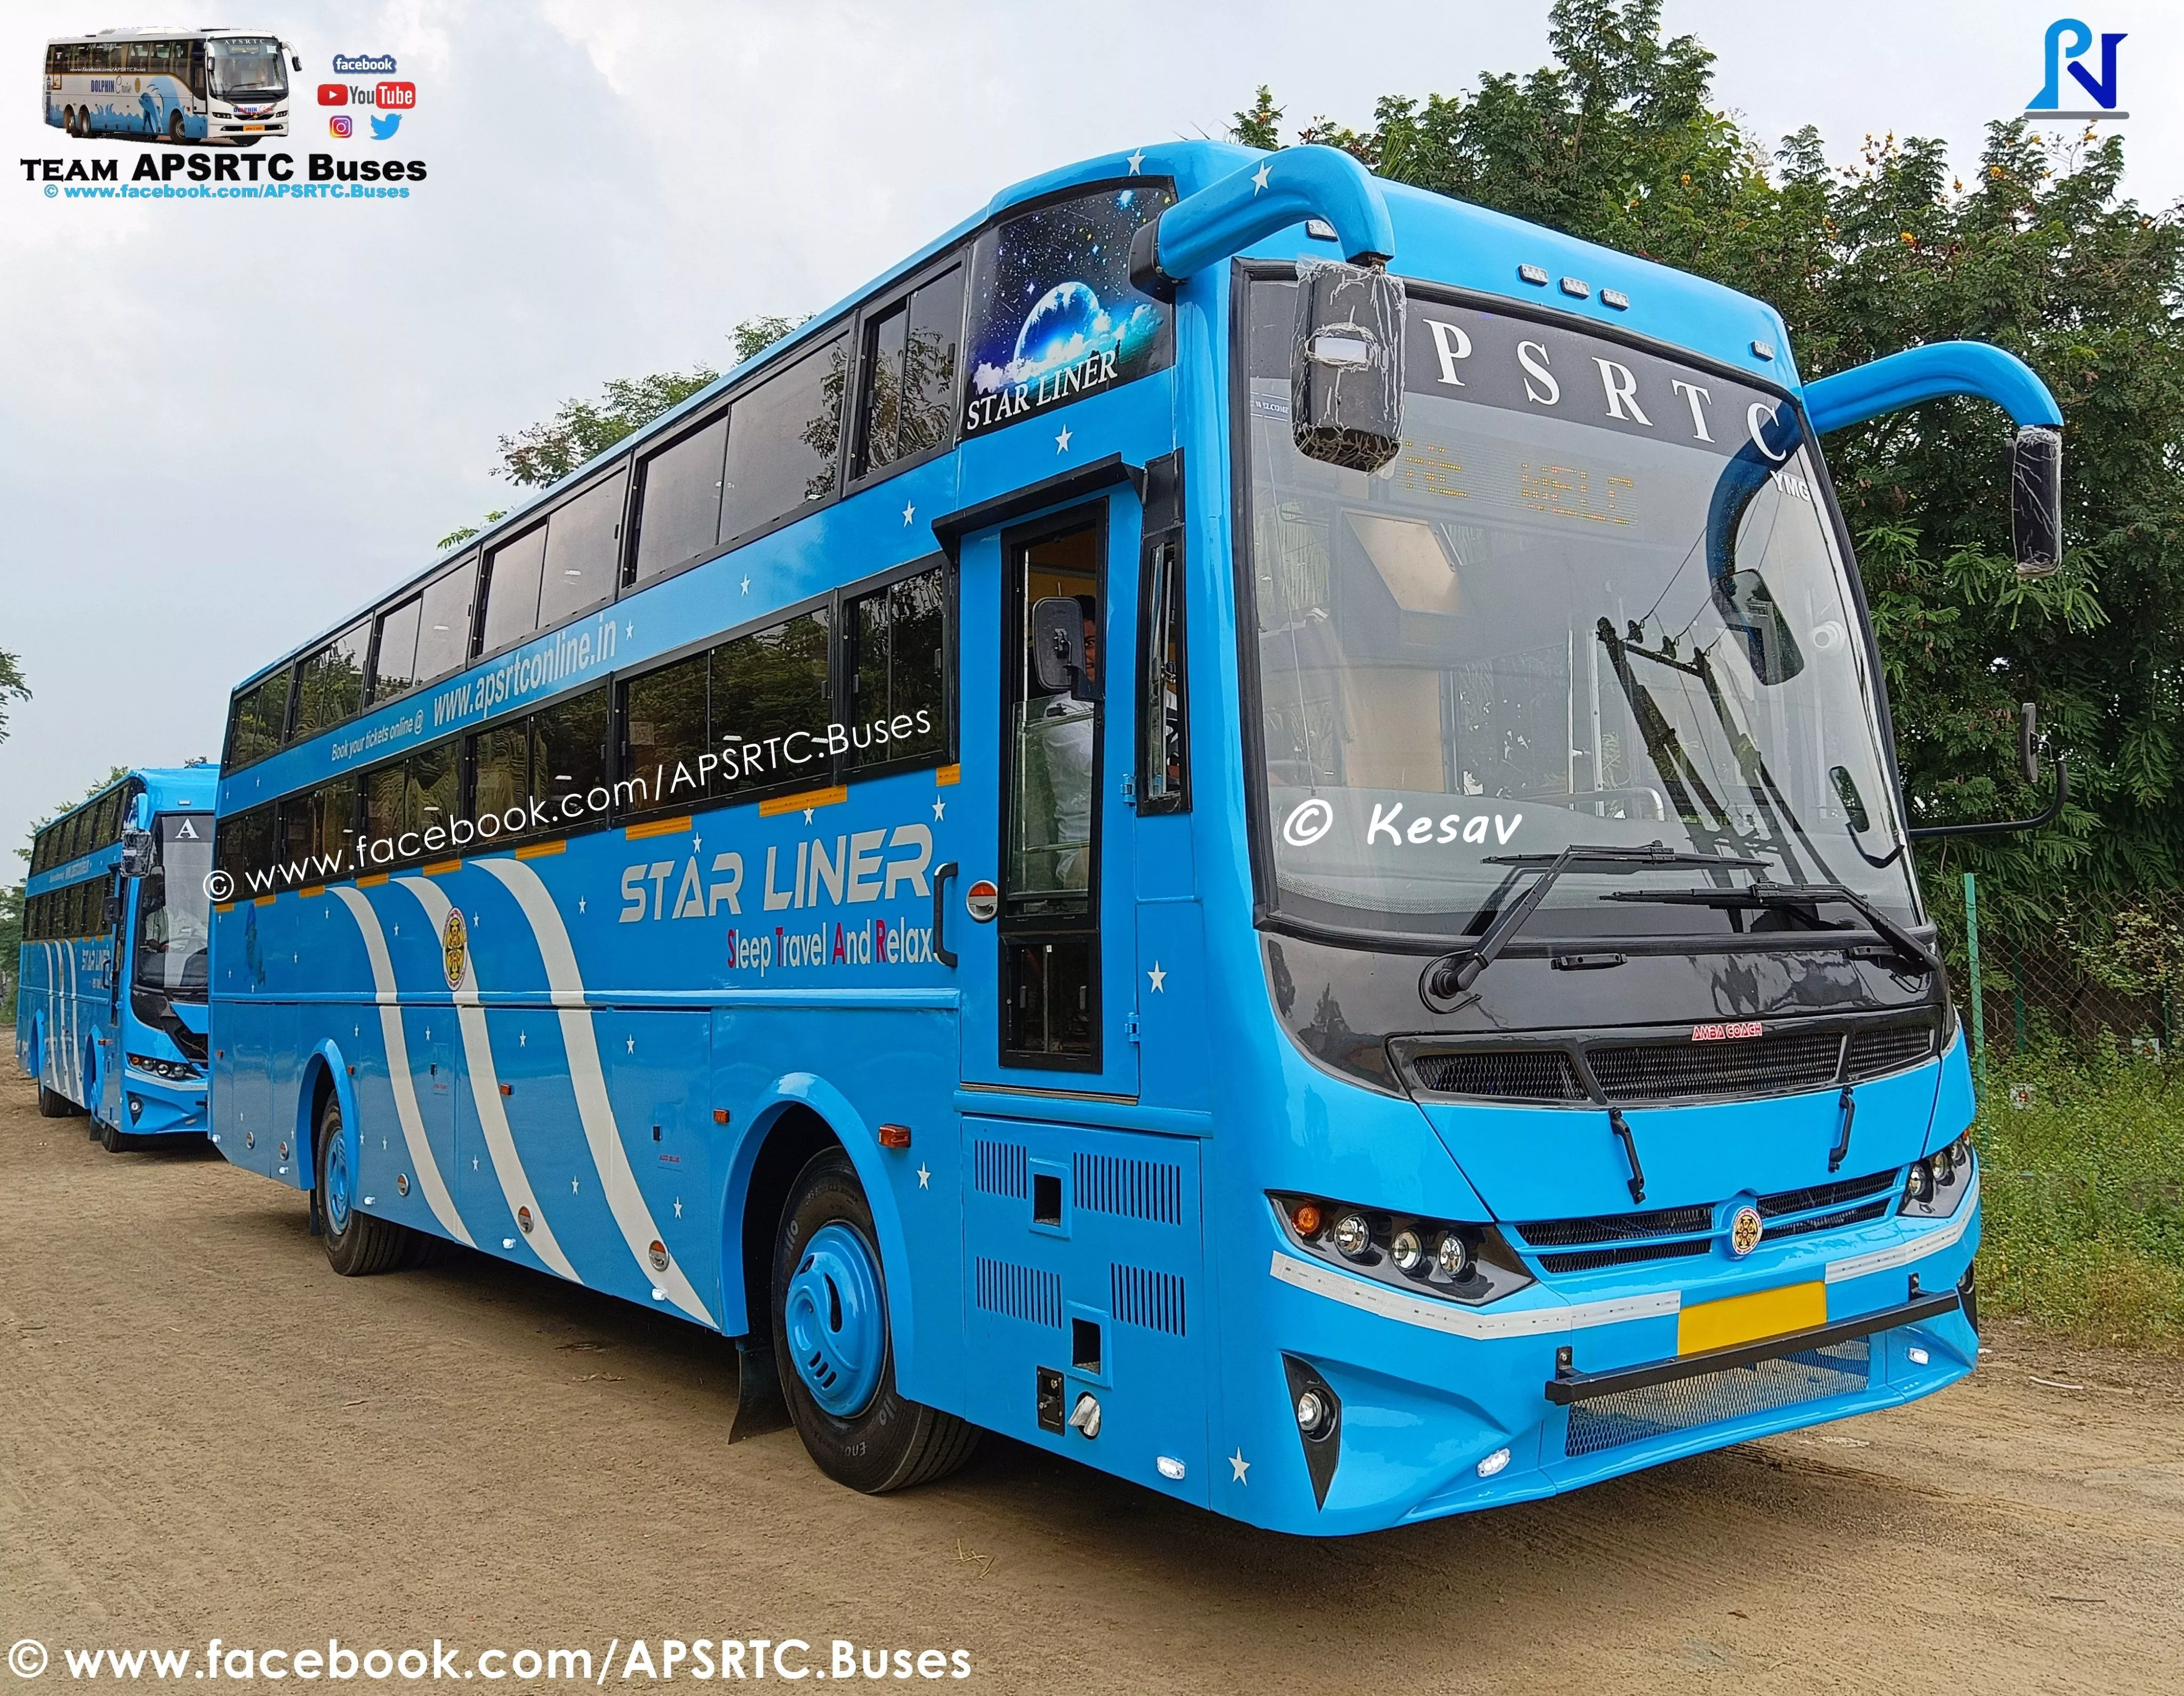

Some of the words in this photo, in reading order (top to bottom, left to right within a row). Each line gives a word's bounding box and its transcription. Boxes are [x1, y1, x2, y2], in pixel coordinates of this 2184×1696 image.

[967, 382, 1030, 431] STAR
[1036, 349, 1118, 407] LINER
[1770, 470, 1811, 502] YMG
[332, 740, 348, 761] Book
[348, 736, 365, 760] your
[365, 724, 389, 749] tickets
[390, 716, 414, 740] online
[433, 613, 617, 727] www.apsrtconline.in
[619, 851, 743, 923] STAR
[764, 823, 934, 911] LINER
[727, 928, 772, 977] Sleep
[775, 922, 826, 968] Travel
[832, 919, 871, 966] And
[876, 917, 933, 964] Relax
[1691, 1024, 1727, 1041] AMBA
[1726, 1022, 1763, 1039] COACH
